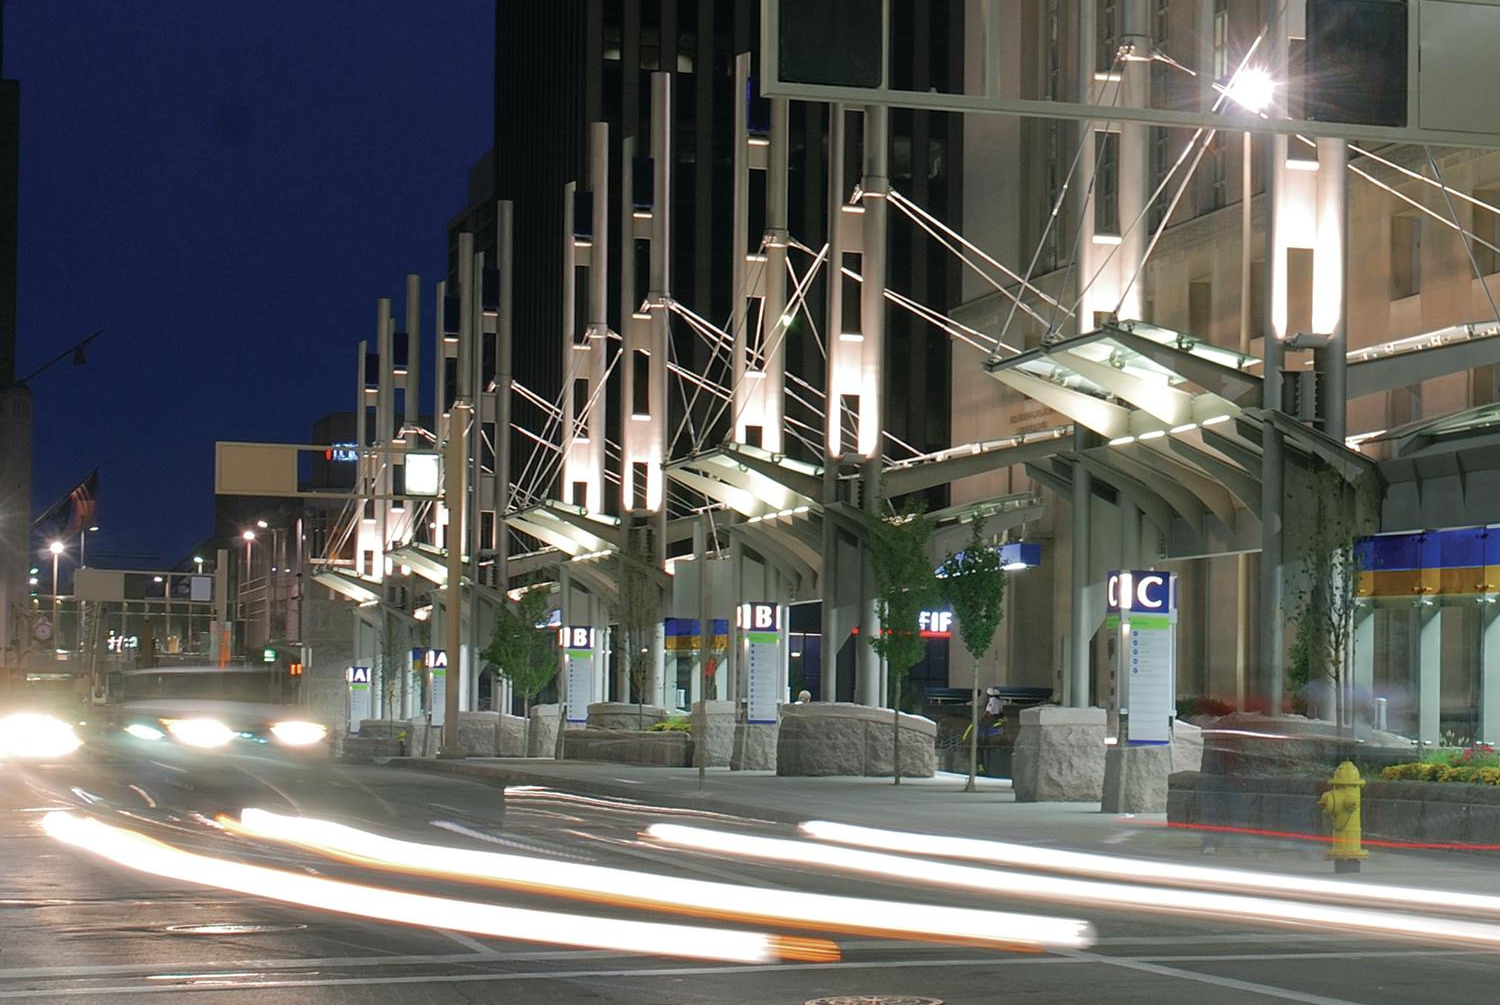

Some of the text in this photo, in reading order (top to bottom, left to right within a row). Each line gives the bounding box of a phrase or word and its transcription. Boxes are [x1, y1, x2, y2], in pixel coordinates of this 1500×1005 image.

[1137, 576, 1163, 608] C
[756, 606, 772, 628] B
[574, 628, 587, 646] B
[435, 651, 448, 667] A
[354, 668, 367, 682] A
